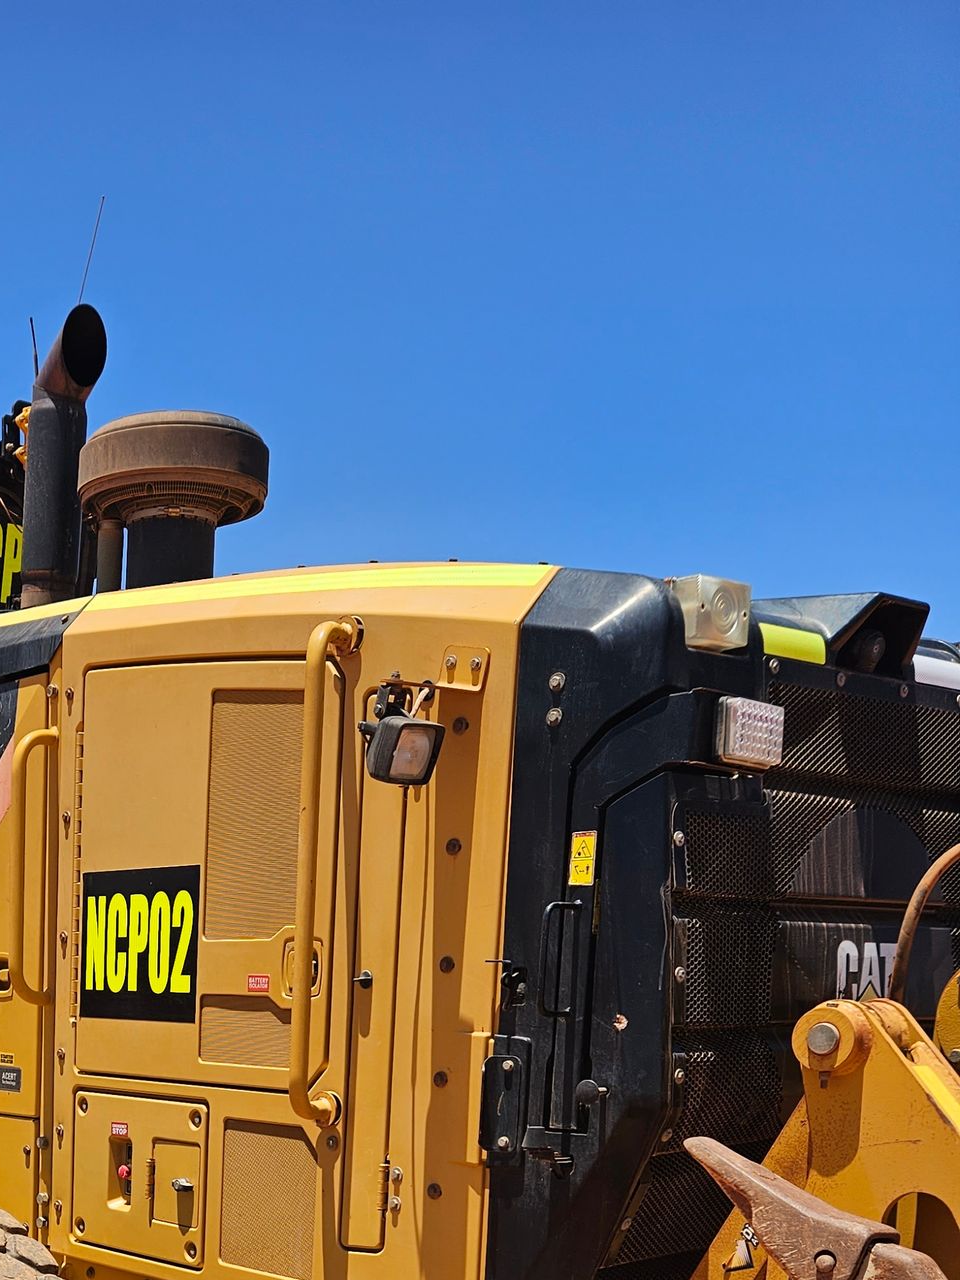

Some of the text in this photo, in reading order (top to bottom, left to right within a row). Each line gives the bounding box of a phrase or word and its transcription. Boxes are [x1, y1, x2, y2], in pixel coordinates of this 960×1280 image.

[85, 889, 194, 995] NCP02
[836, 940, 898, 1000] CAT
[1, 1071, 17, 1081] ACERT
